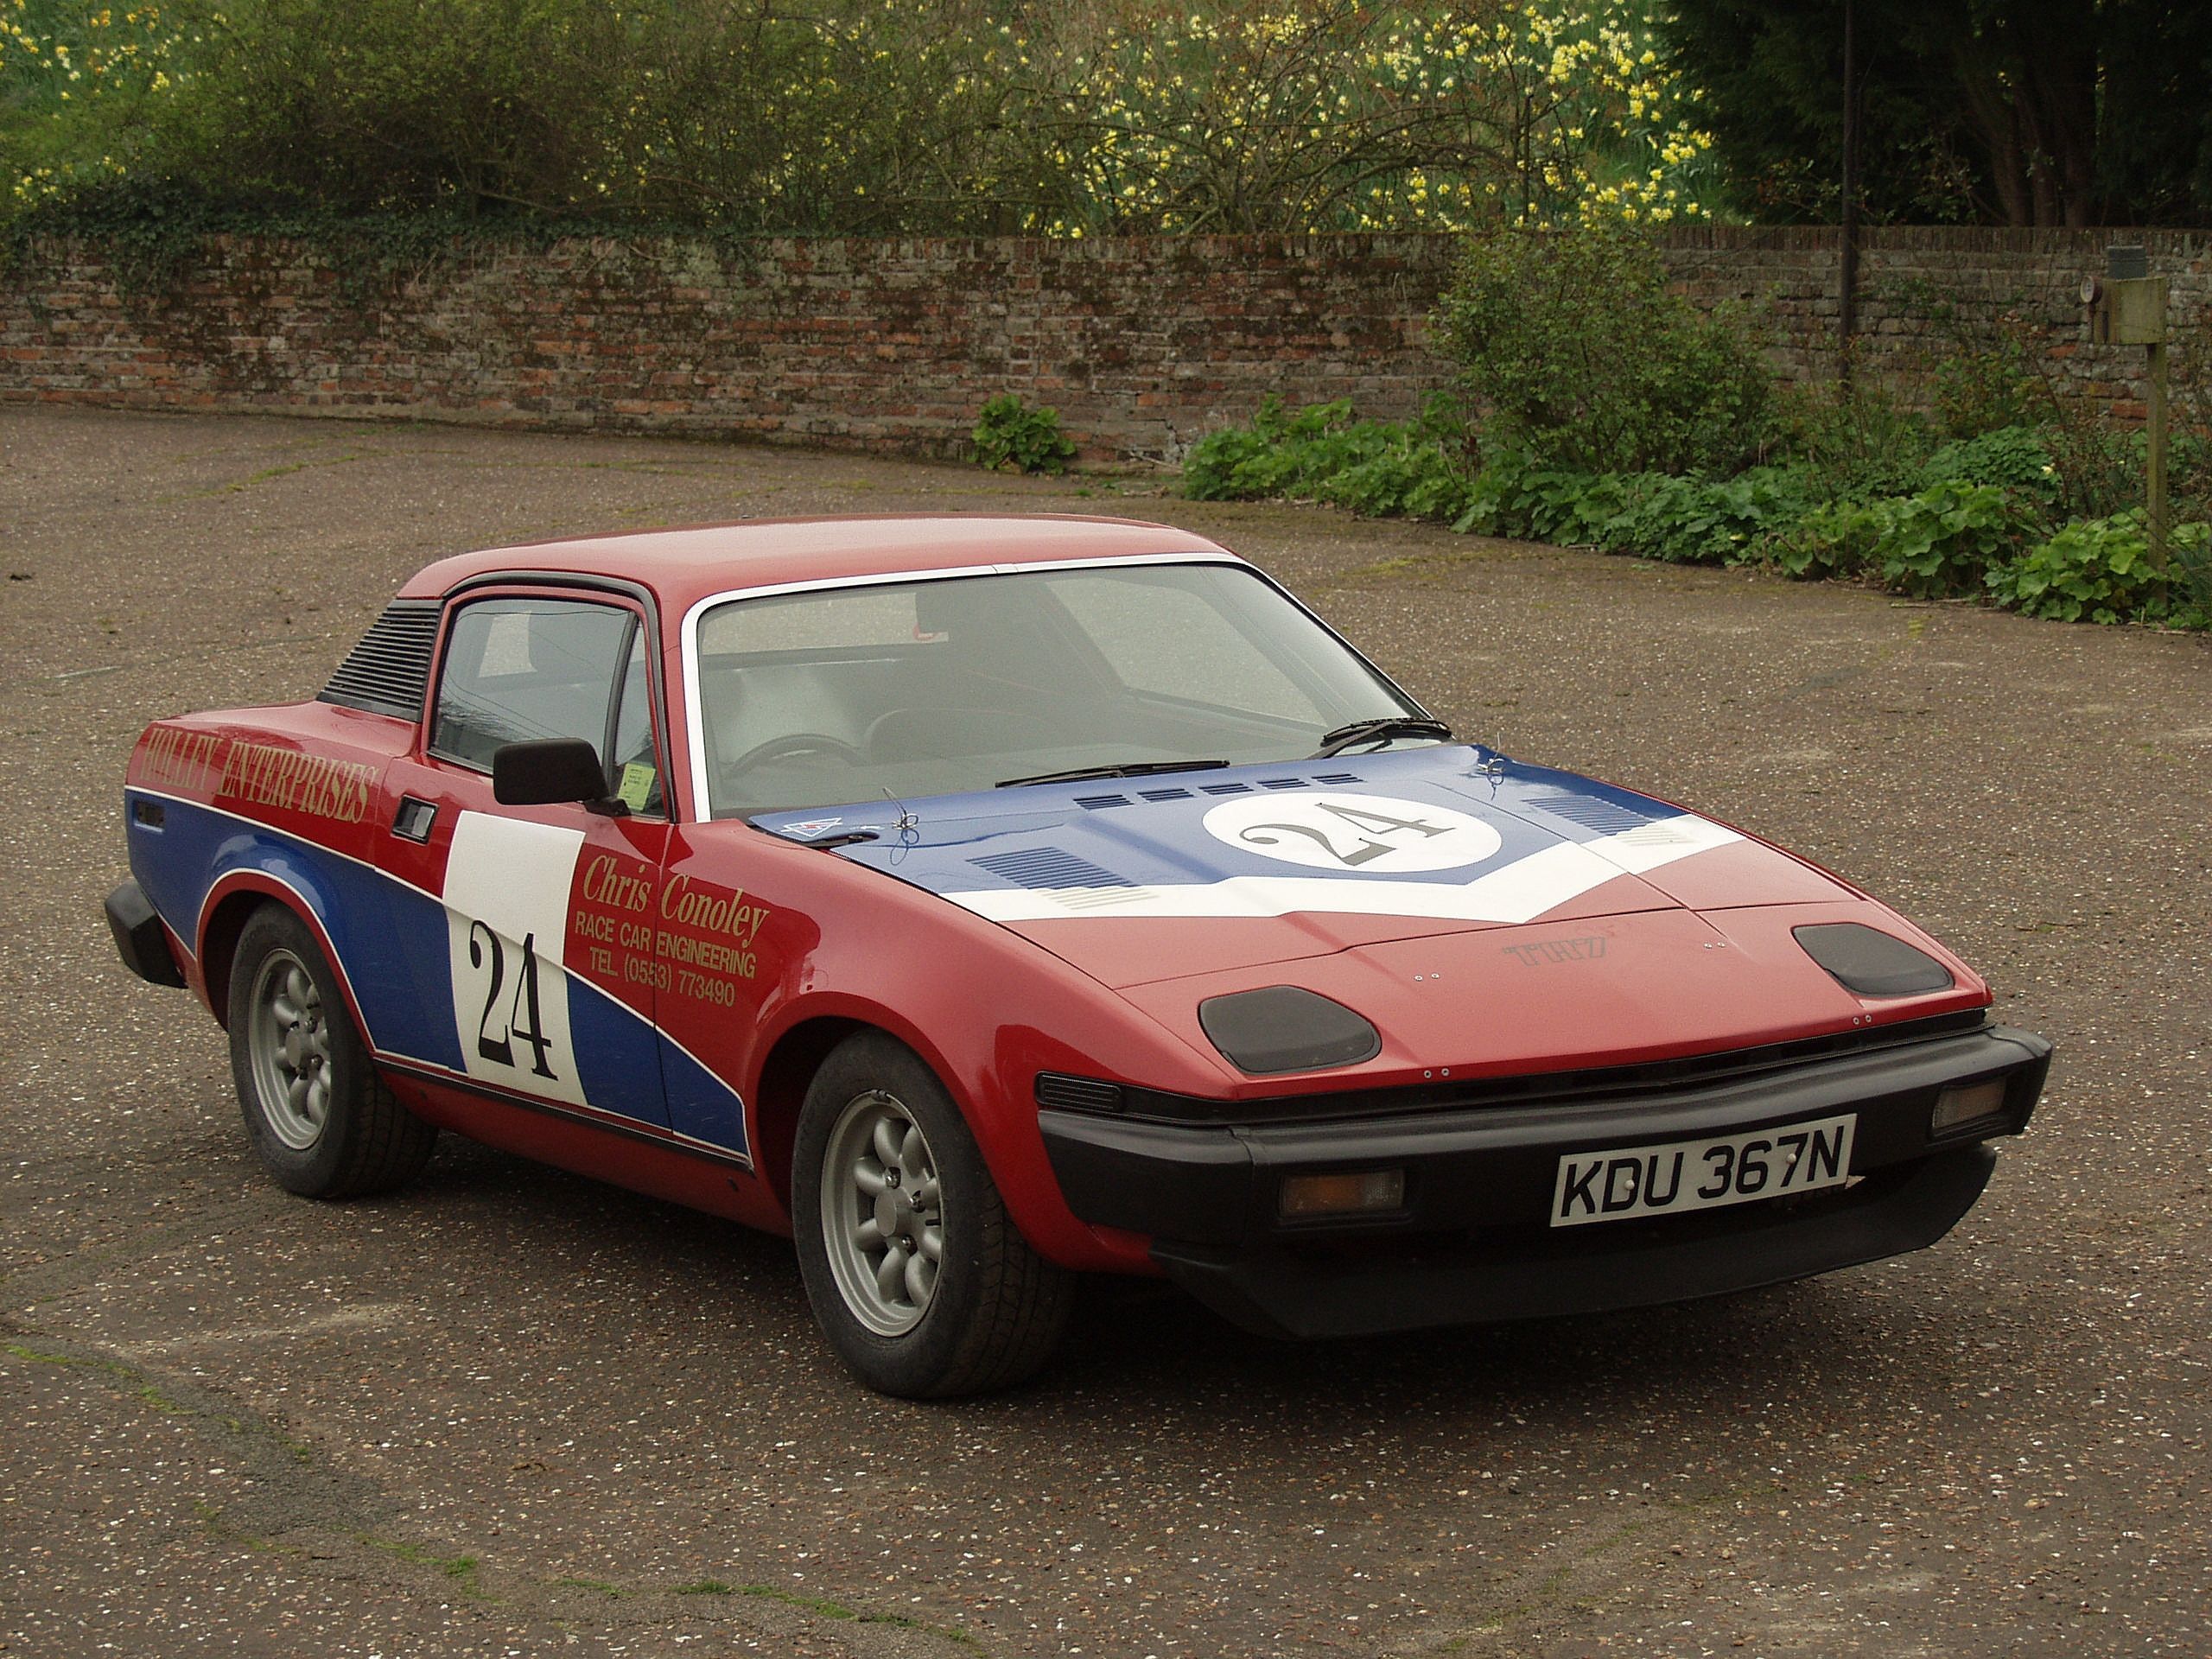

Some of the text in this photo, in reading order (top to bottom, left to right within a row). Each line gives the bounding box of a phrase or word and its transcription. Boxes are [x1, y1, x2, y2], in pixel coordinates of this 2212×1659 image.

[217, 741, 380, 824] ENTERPRISES
[1239, 802, 1457, 867] 24
[583, 855, 771, 949] Chris Conoley
[575, 911, 758, 979] RACE CAR ENGINEERING
[625, 953, 672, 993] (0553)
[678, 969, 734, 1007] 773490
[469, 919, 559, 1081] 24
[1560, 1125, 1845, 1218] KDU 367N
